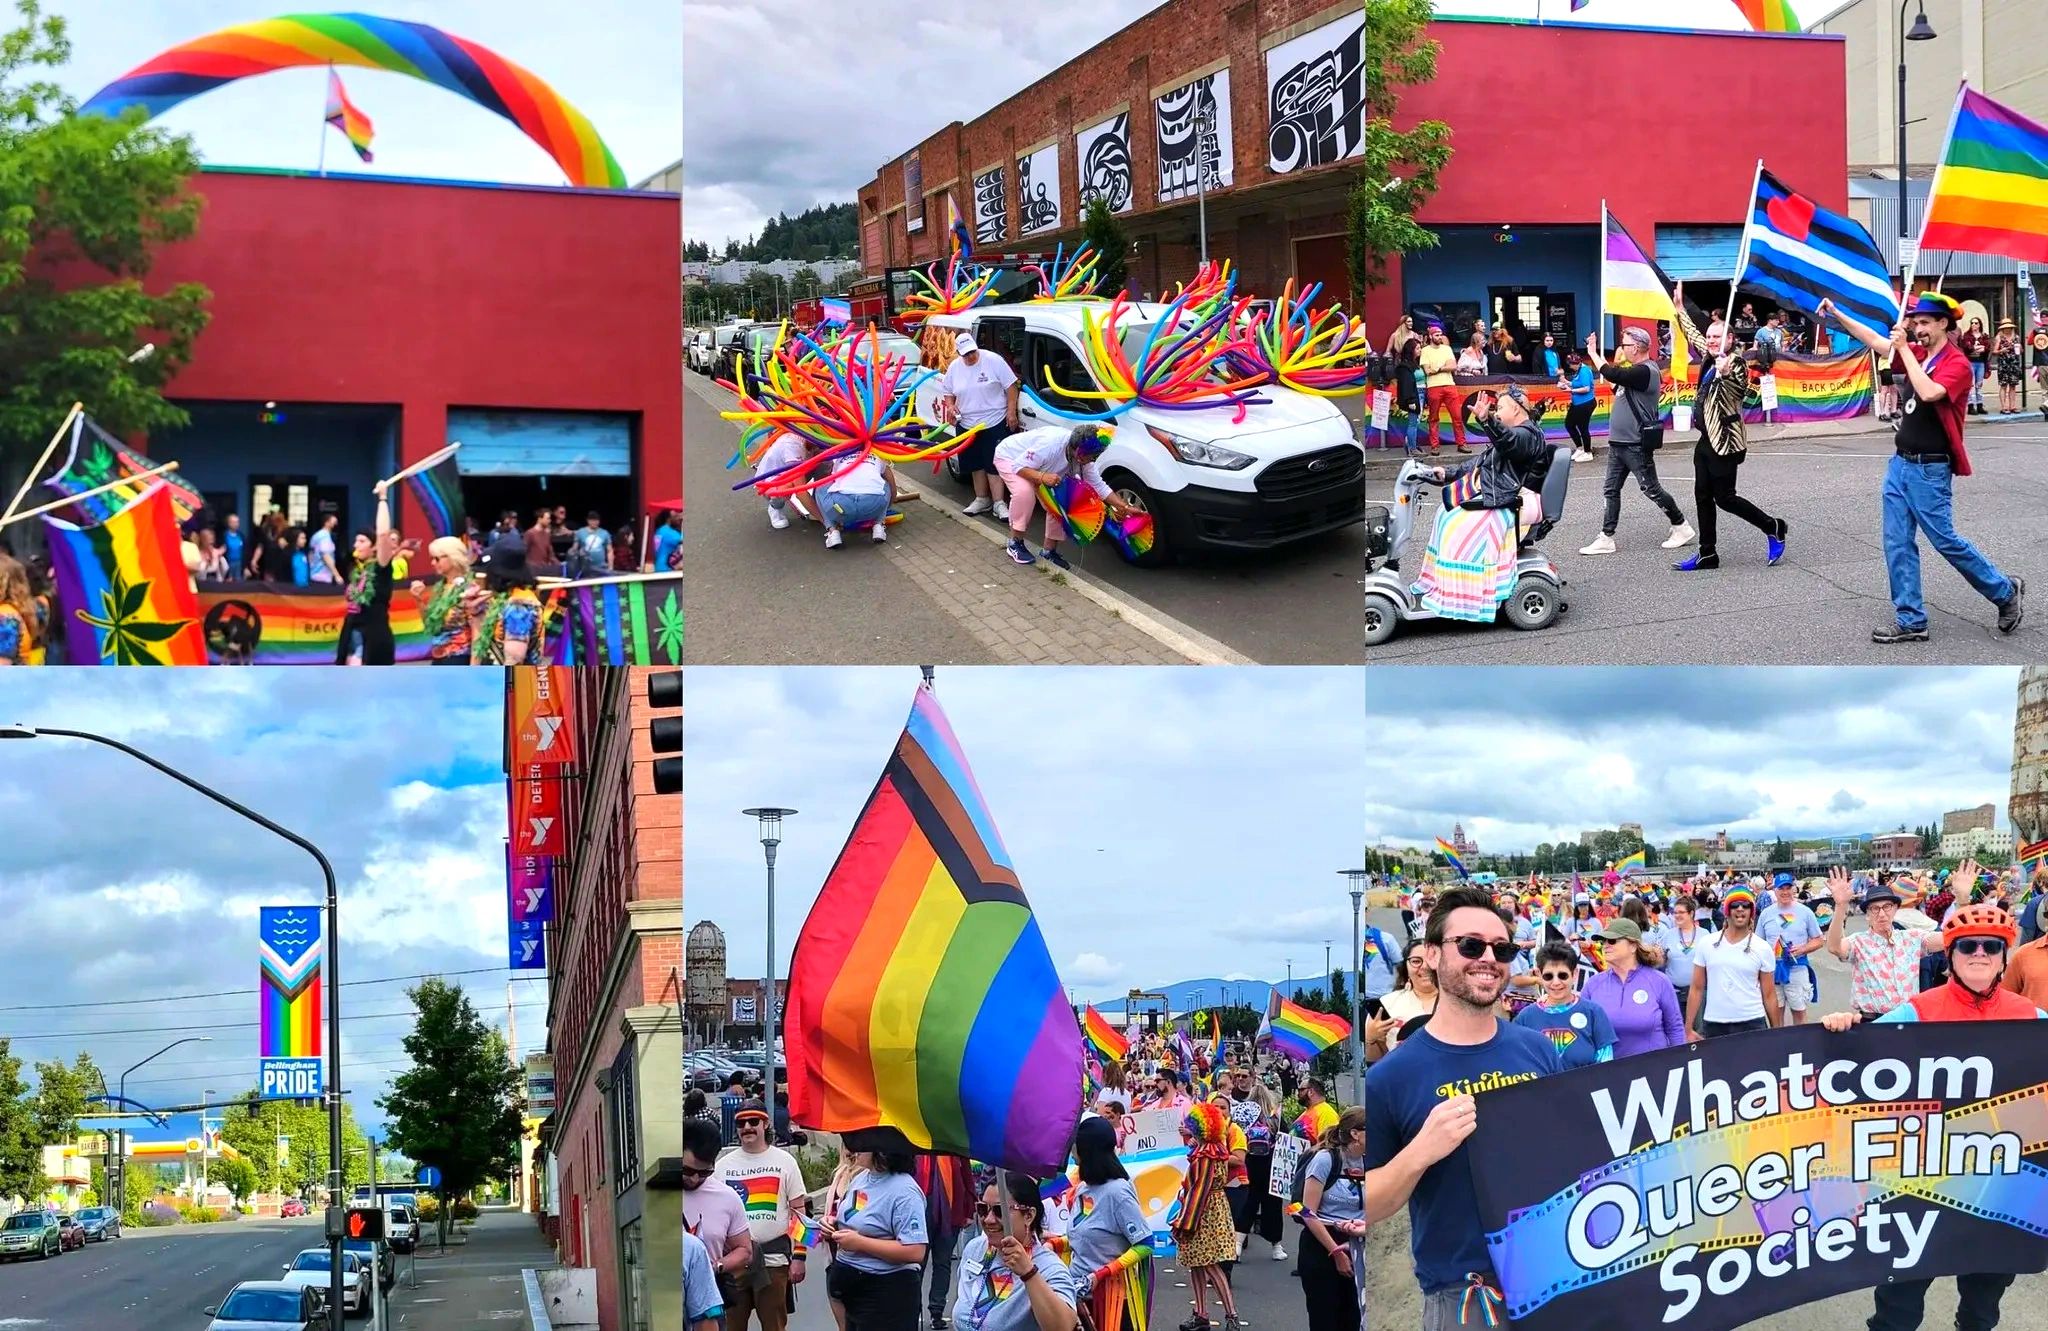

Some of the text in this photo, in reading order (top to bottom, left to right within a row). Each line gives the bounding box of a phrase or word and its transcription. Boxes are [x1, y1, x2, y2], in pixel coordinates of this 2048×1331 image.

[1802, 383, 1826, 392] BACK
[304, 622, 338, 634] BACK
[263, 1062, 317, 1071] Bellingham
[263, 1070, 318, 1095] PRIDE
[1436, 1070, 1539, 1100] Kindness
[1591, 1053, 1994, 1158] Whatcom
[1137, 1135, 1157, 1150] AND
[725, 1166, 781, 1177] BELLINGHAM
[1271, 1179, 1291, 1195] EQU
[1566, 1112, 2023, 1270] Queer Film
[1659, 1202, 1940, 1324] Society
